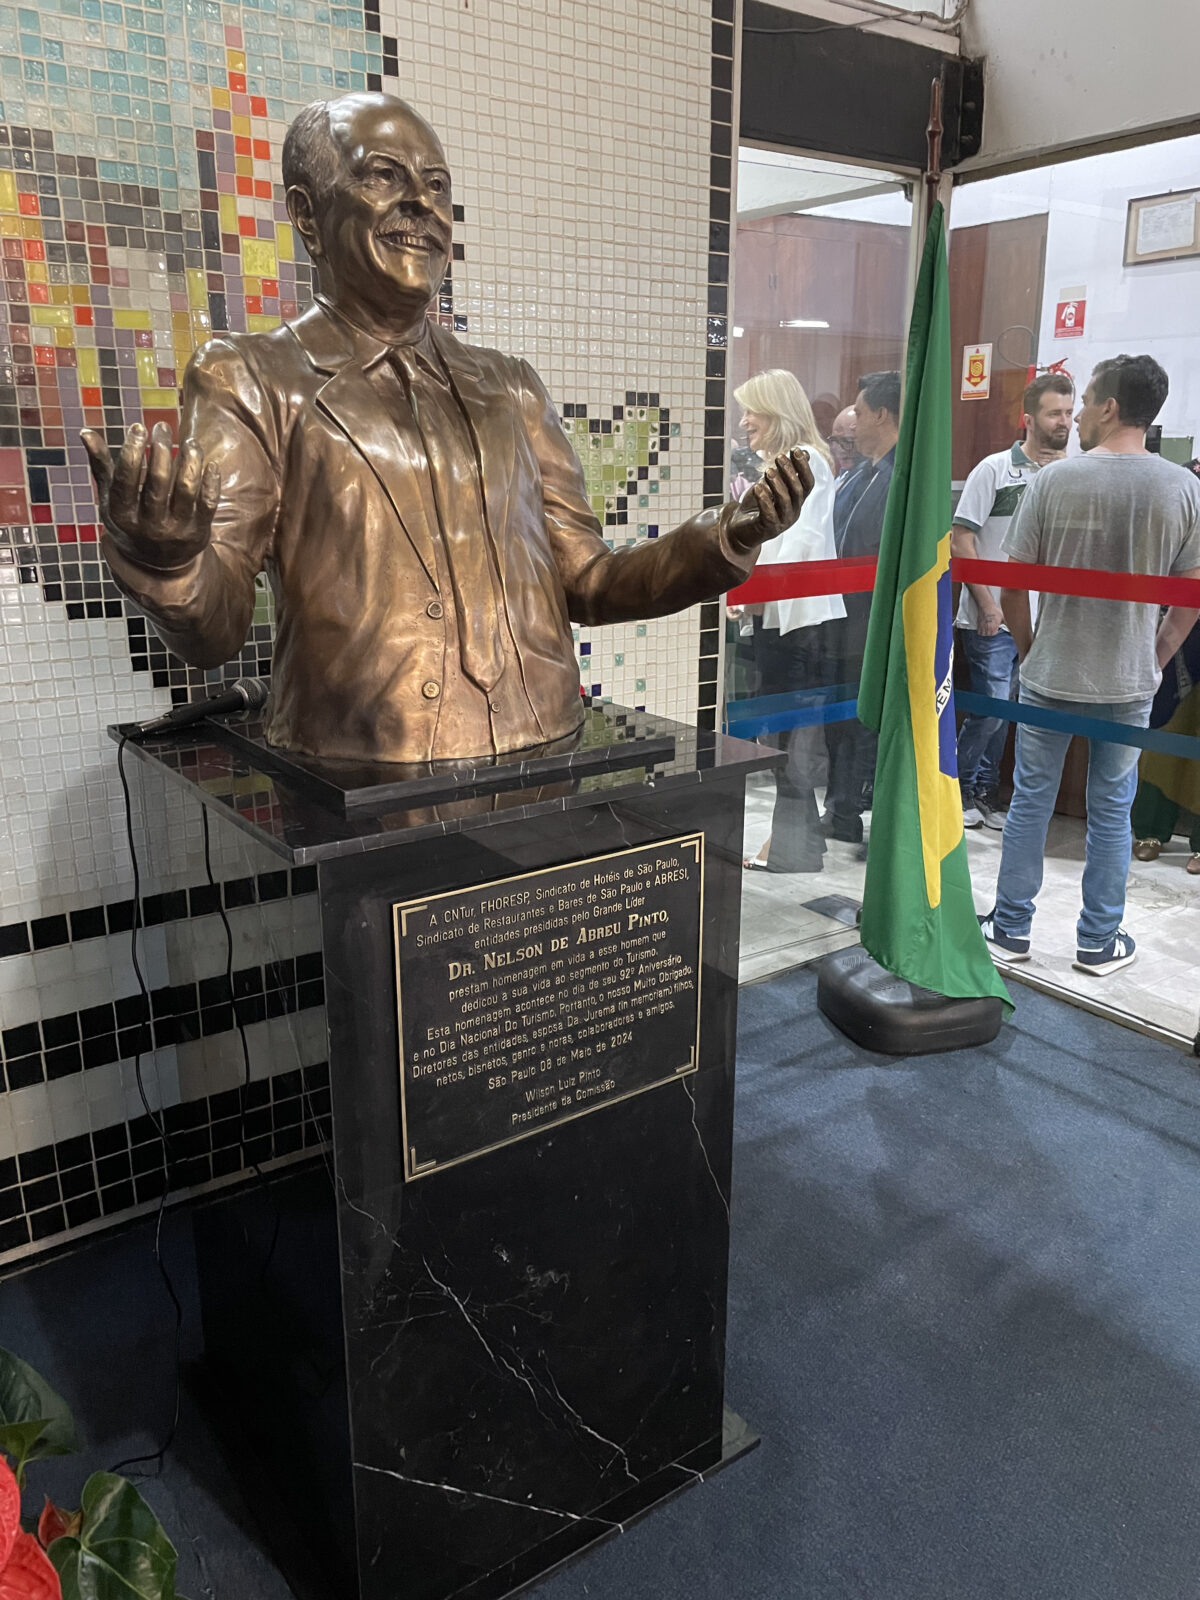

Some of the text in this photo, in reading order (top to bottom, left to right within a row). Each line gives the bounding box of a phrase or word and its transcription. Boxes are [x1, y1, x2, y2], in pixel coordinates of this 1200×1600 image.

[416, 867, 690, 947] Sindicato de Restaurantes e Bares de São Paulo e ABRESI,
[429, 914, 438, 927] A
[480, 891, 530, 914] FHORESP,
[536, 882, 576, 900] Sindicato
[580, 879, 590, 889] de
[593, 871, 620, 886] Hotéis
[623, 868, 634, 879] de
[637, 863, 653, 876] São
[656, 857, 680, 871] Paulo,
[474, 896, 645, 950] entidades presididas pelo Grande Líder
[448, 962, 475, 981] DR.
[484, 943, 543, 970] NELSON
[551, 937, 569, 952] DE
[576, 922, 621, 945] ABREU
[449, 930, 666, 1002] prestam homenagem em vida a esse homem que
[461, 947, 659, 1013] dedicou a sua vida ao segmento do Turismo.
[1112, 938, 1127, 957] N
[412, 1056, 458, 1078] Diretores
[461, 1049, 479, 1062] das
[483, 1033, 529, 1055] entidades,
[532, 1022, 563, 1039] esposa
[584, 1004, 616, 1022] Jurema
[618, 1000, 628, 1011] (in
[630, 985, 673, 1007] memoriam)
[413, 1052, 419, 1062] e
[423, 1047, 436, 1059] no
[439, 1040, 456, 1053] Dia
[460, 1024, 501, 1046] Nacional
[505, 1020, 517, 1032] Do
[521, 1009, 557, 1027] Turismo.
[559, 996, 598, 1014] Portanto,
[599, 993, 605, 1002] o
[607, 985, 631, 999] nosso
[633, 977, 656, 992] Muito
[427, 1026, 450, 1041] Esta
[455, 1007, 512, 1032] homenagem
[515, 993, 555, 1013] acontece
[558, 989, 569, 999] no
[572, 984, 585, 995] dia
[588, 979, 599, 990] de
[602, 974, 617, 986] seu
[638, 954, 682, 976] Aniversário
[436, 1071, 466, 1087] netos,
[468, 1056, 508, 1077] bisnetos,
[511, 1045, 537, 1064] genro
[540, 1043, 545, 1052] e
[577, 1013, 635, 1040] colaboradores
[638, 1011, 643, 1019] e
[488, 1031, 633, 1090] São Paulo 08 de Maio de 2024
[511, 1078, 616, 1125] Presidente da Comissão
[525, 1068, 601, 1103] Wilson Luiz Pinto
